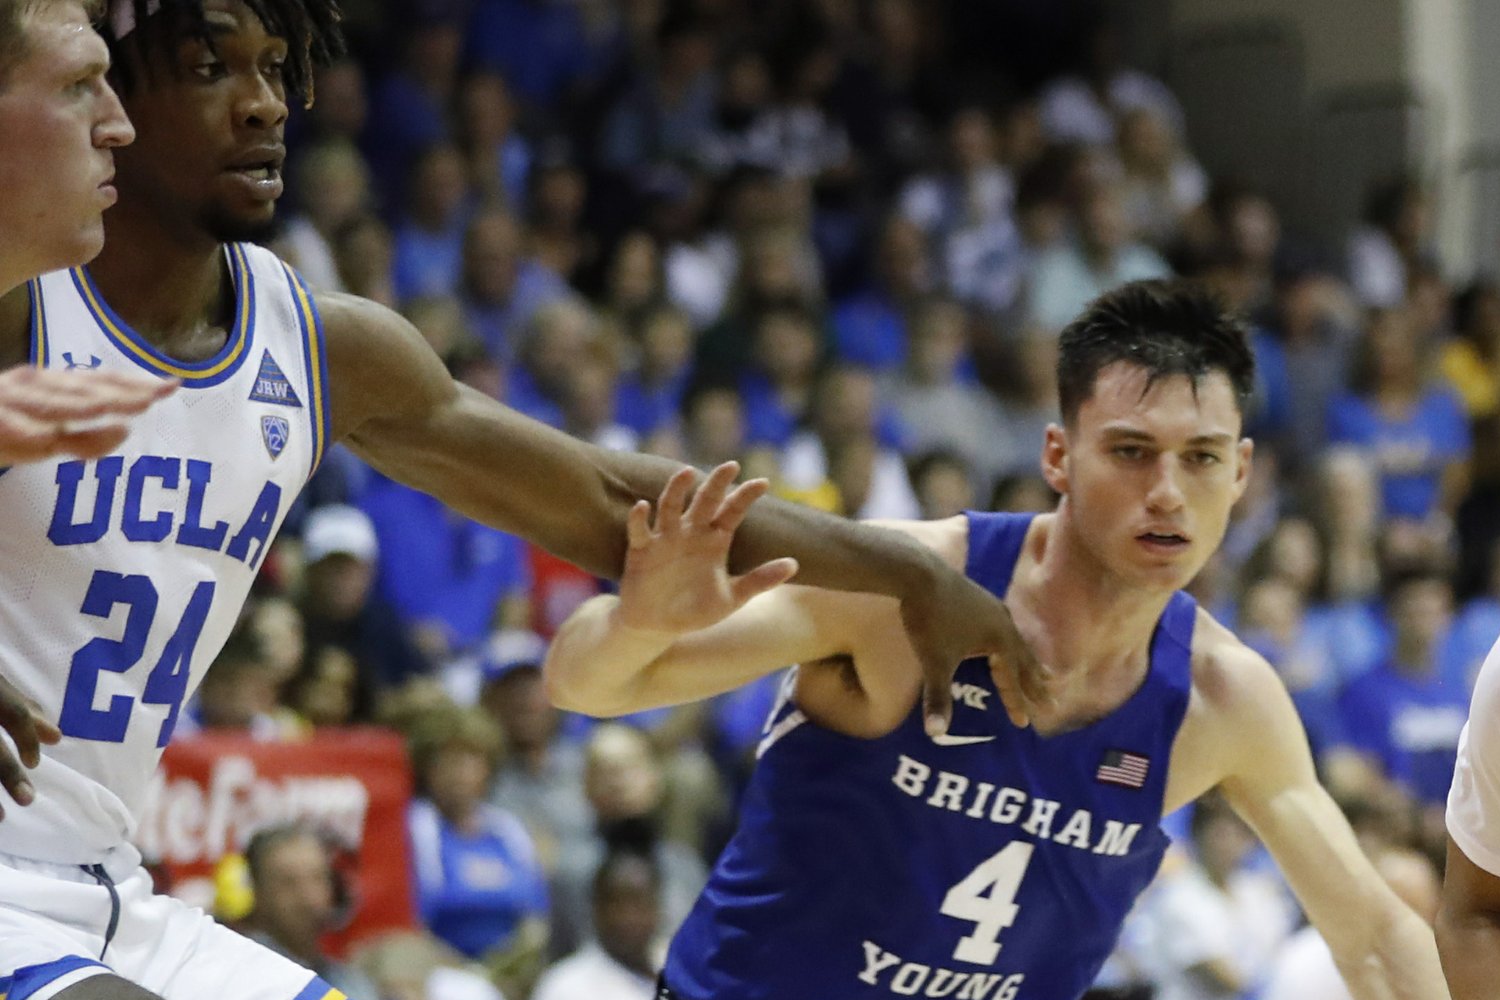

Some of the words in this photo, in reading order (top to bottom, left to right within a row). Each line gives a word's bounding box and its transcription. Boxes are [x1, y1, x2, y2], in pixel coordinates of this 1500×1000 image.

[256, 381, 289, 398] JRW
[47, 455, 283, 572] UCLA
[58, 569, 217, 749] 24
[891, 755, 1142, 857] BRIGHAM
[939, 840, 1036, 966] 4
